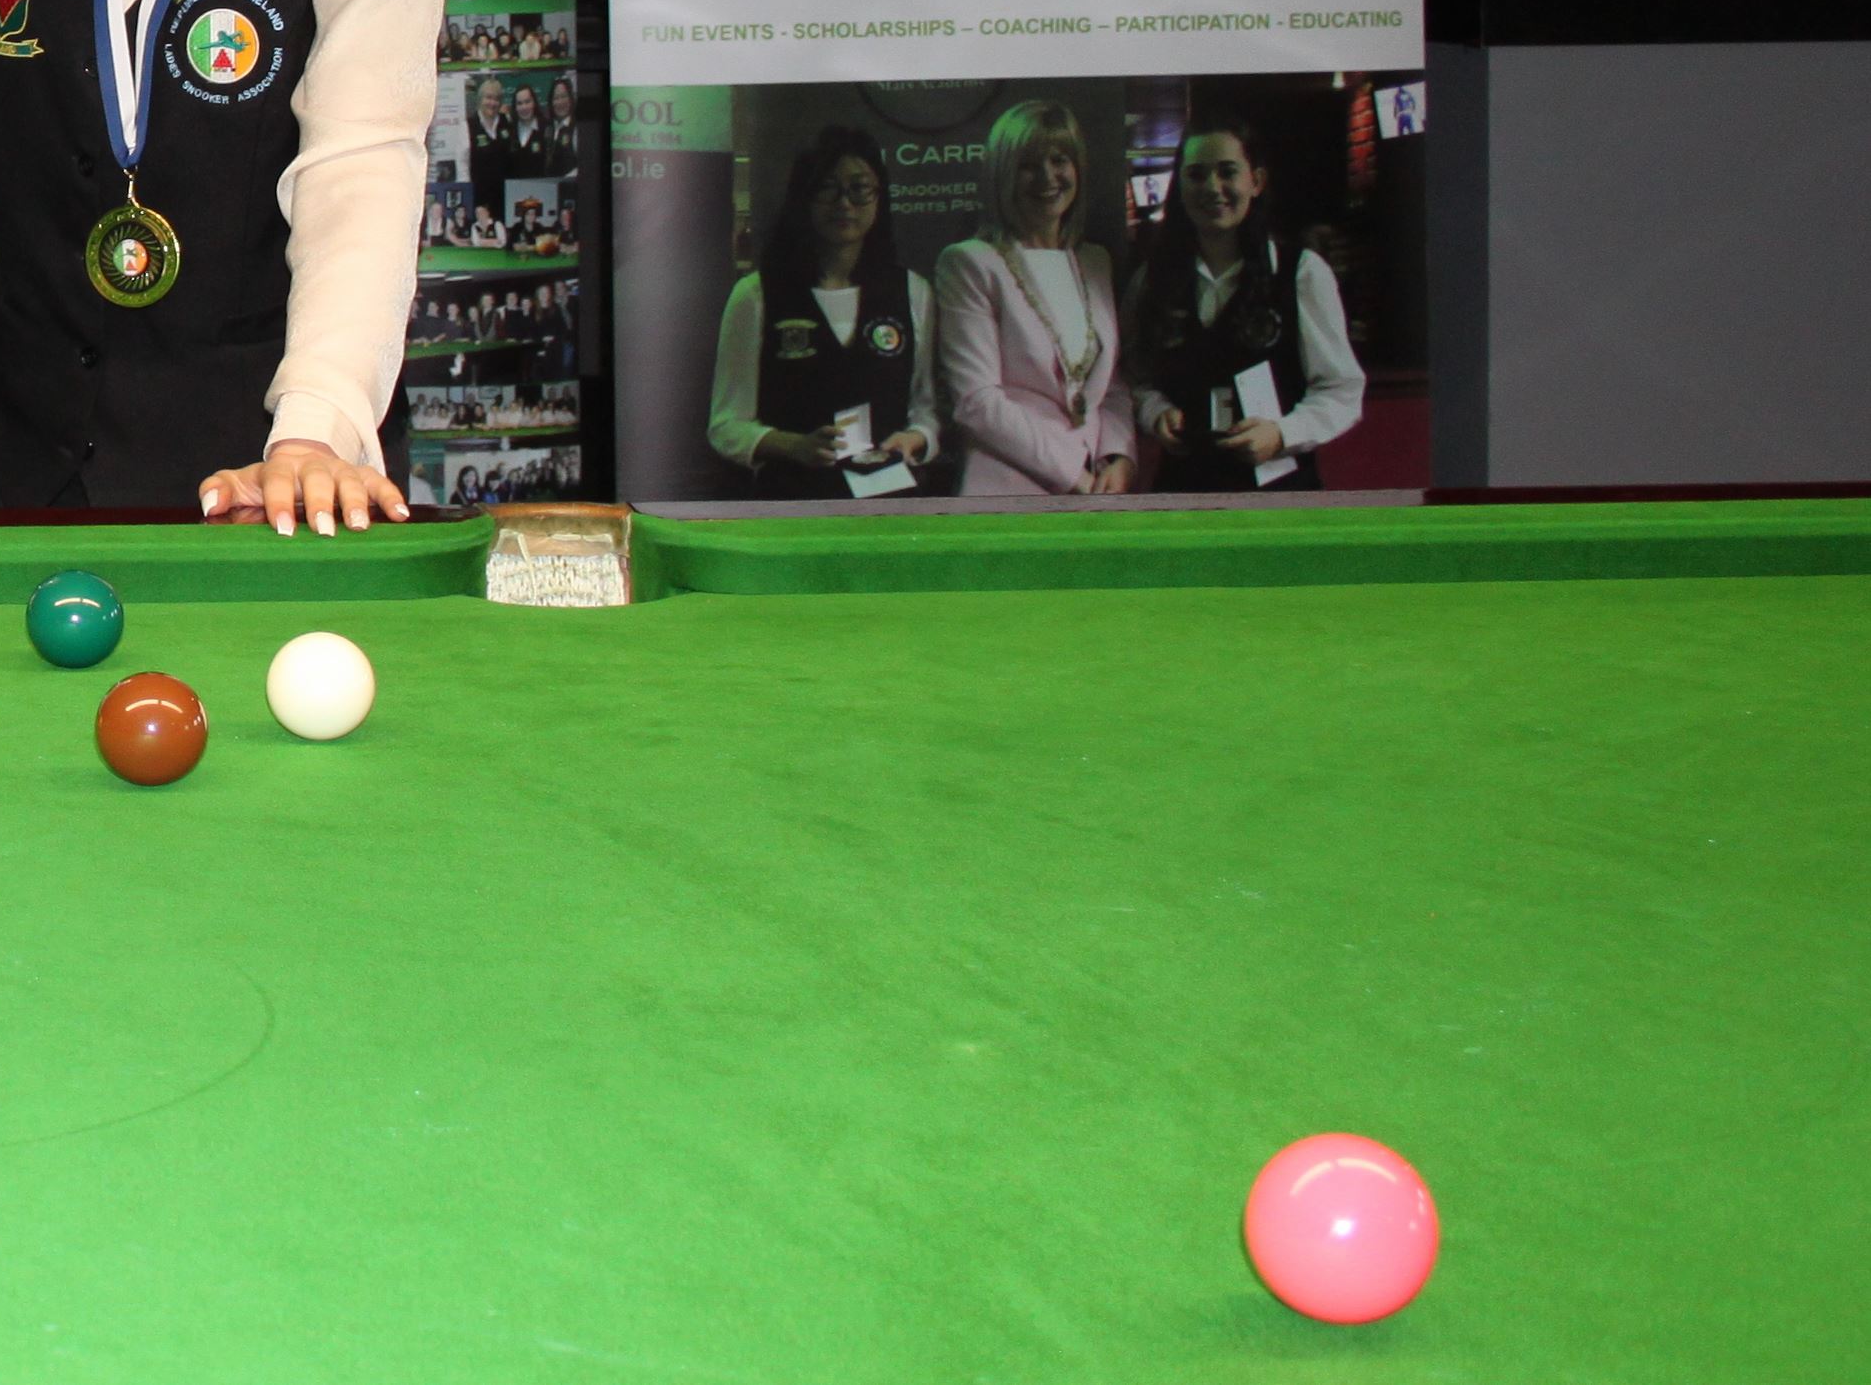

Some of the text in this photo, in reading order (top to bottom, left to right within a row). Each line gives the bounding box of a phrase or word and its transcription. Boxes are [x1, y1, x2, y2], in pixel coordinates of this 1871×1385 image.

[642, 11, 1404, 42] FUN EVENTS SCHOLARSHIPS COACHING PARTICIPATION EDUCATING
[182, 80, 229, 104] SNOOKER
[237, 47, 283, 102] ASSOCIATION
